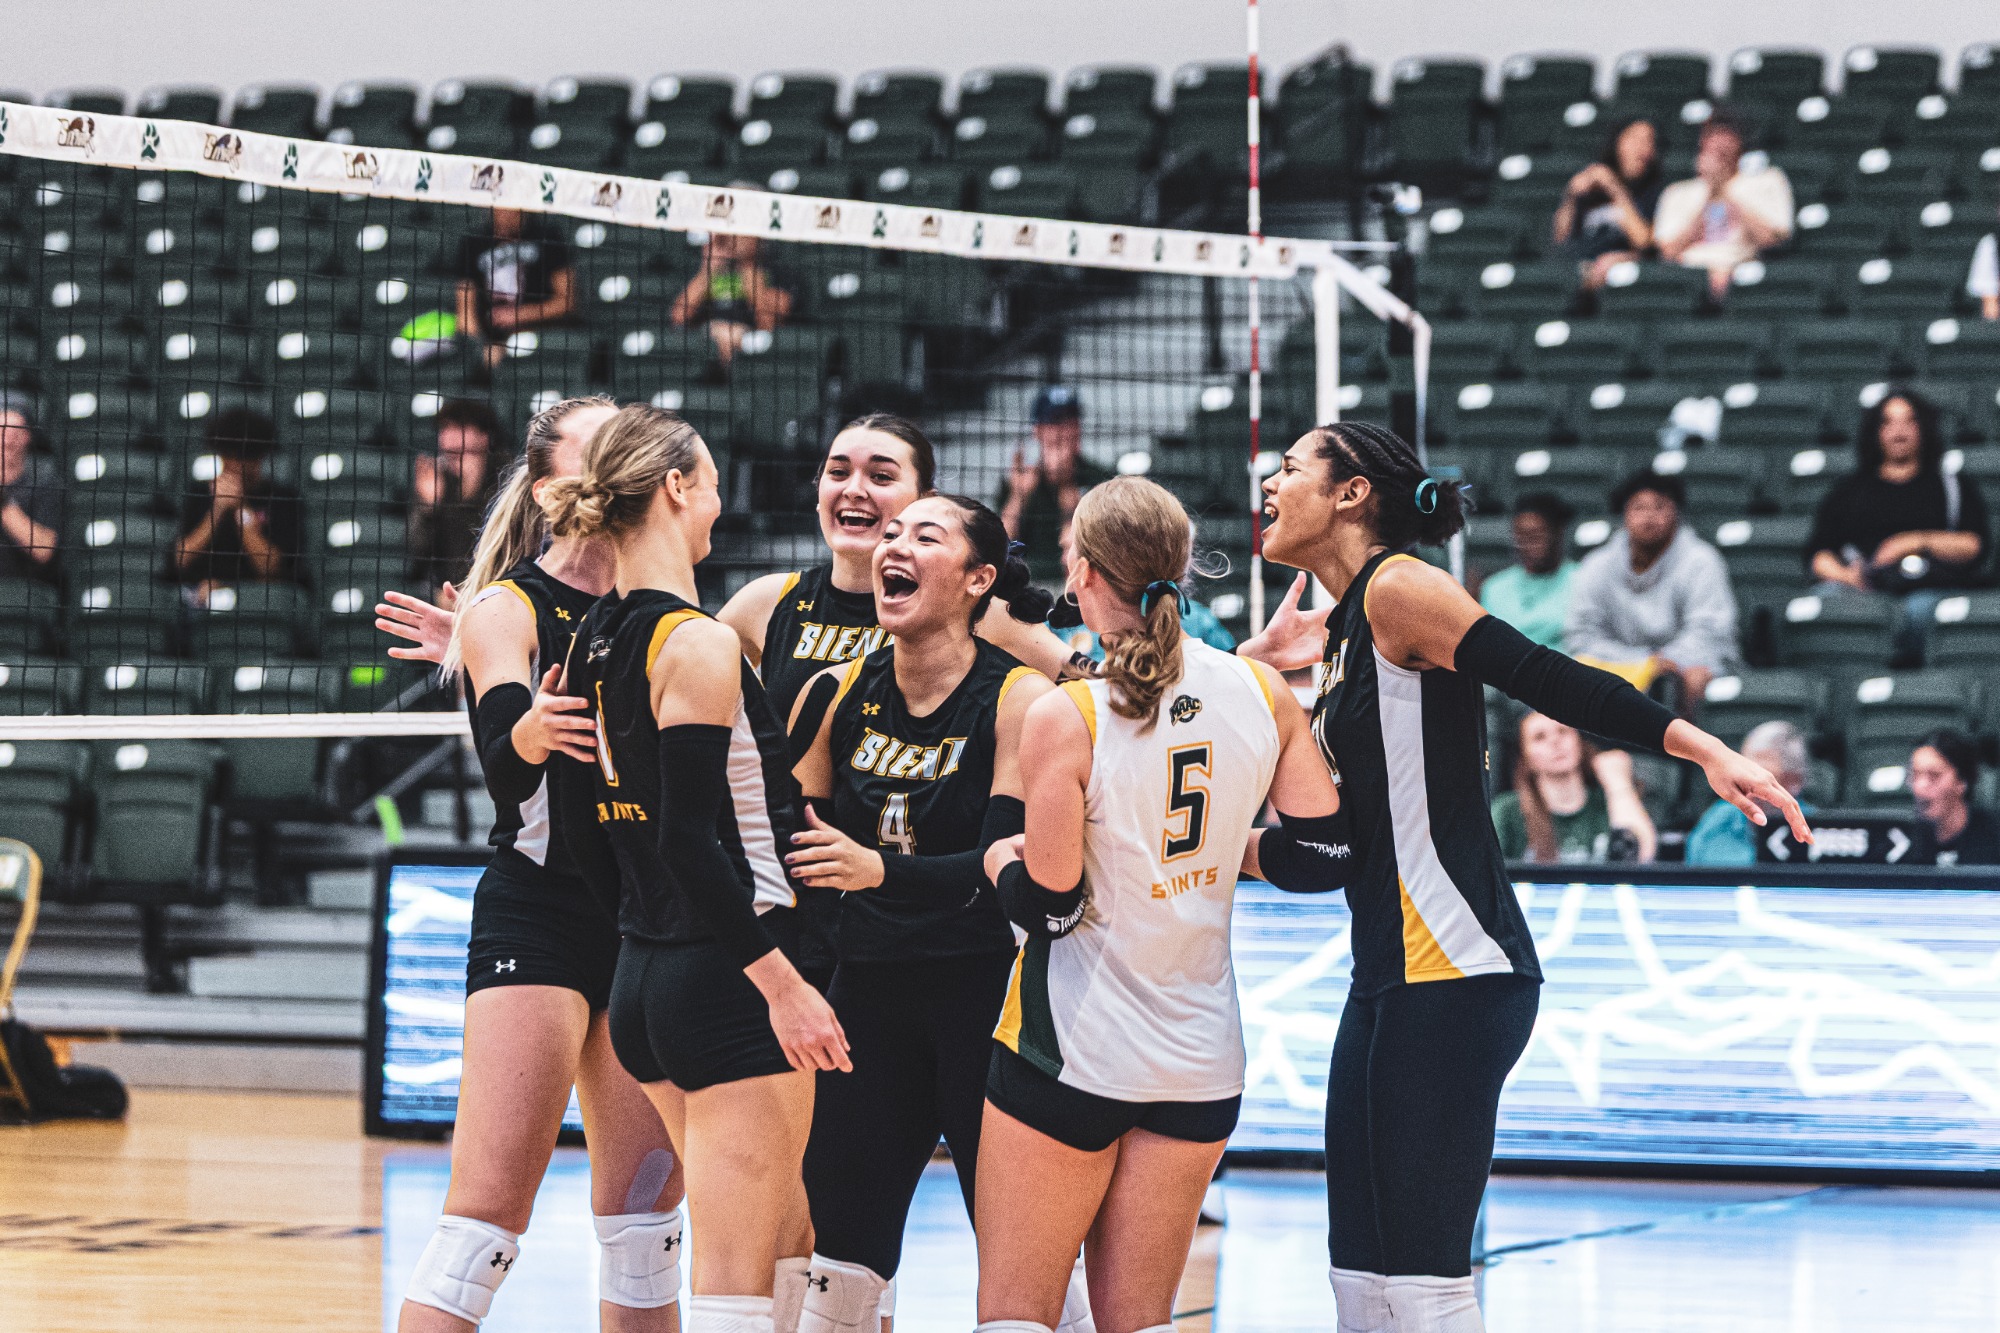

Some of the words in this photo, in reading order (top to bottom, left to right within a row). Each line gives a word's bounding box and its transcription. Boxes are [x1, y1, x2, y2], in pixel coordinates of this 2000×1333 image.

[793, 621, 895, 662] SIEN
[877, 793, 917, 855] 4
[1161, 741, 1213, 864] 5
